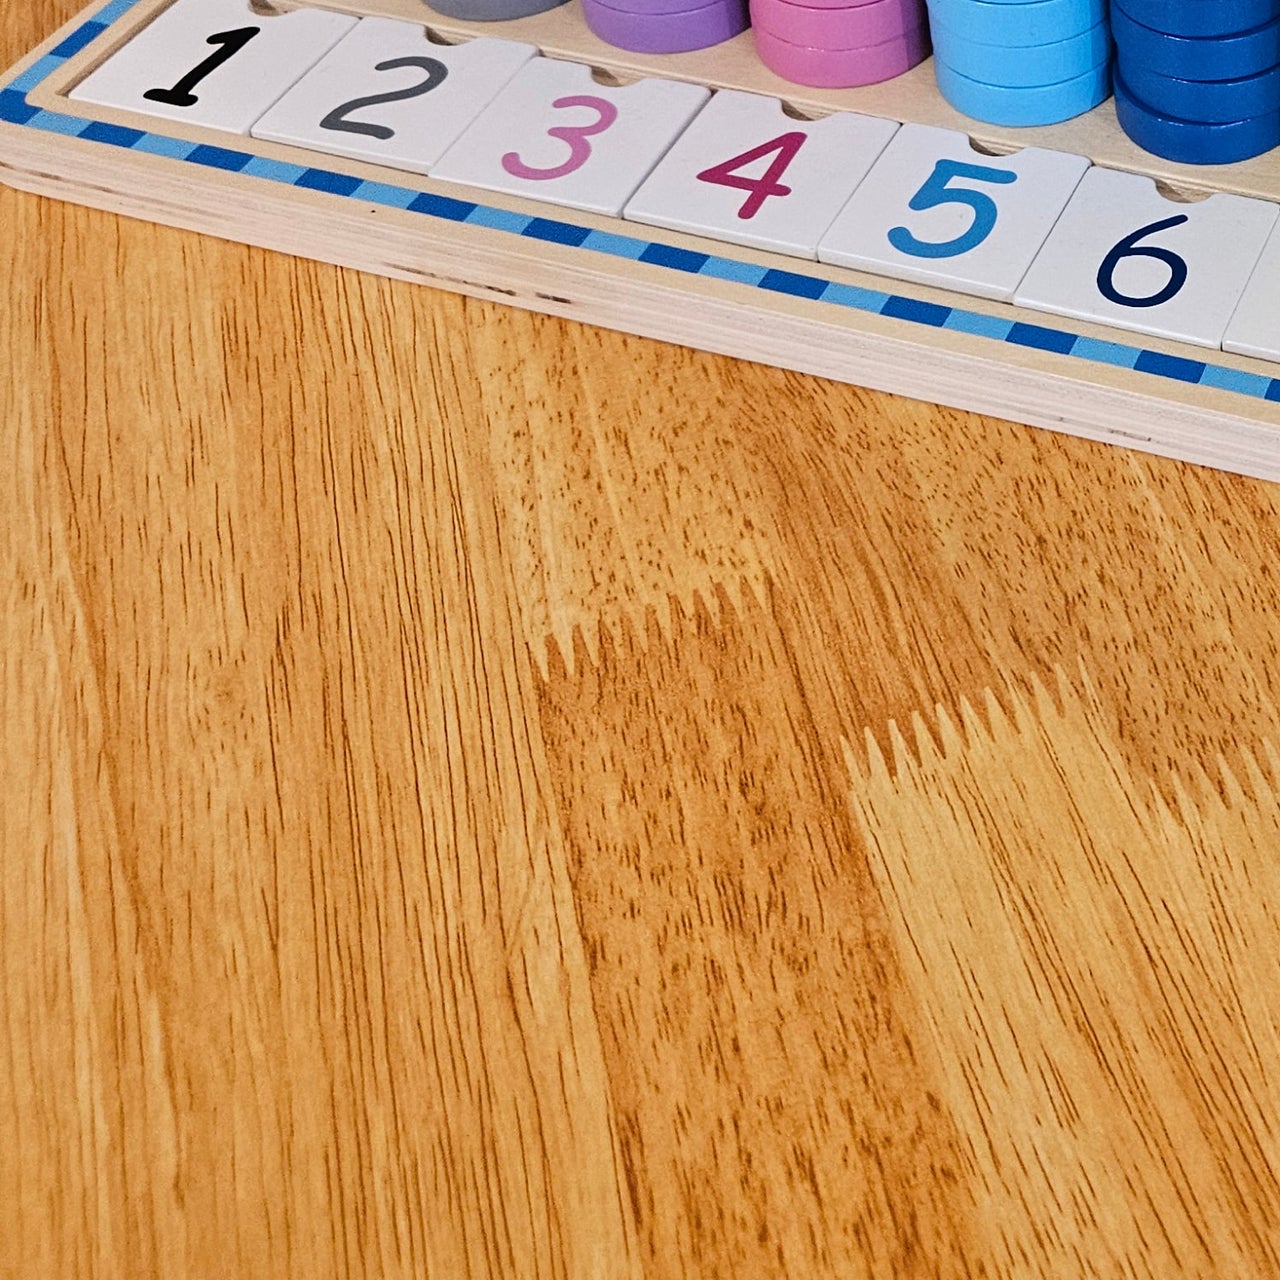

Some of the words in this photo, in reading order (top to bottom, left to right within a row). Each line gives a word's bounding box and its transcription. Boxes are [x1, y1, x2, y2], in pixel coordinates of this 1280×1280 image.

[143, 26, 261, 107] 1
[319, 56, 449, 140] 2
[501, 95, 618, 181] 3
[696, 131, 807, 220] 4
[887, 158, 1018, 259] 5
[1096, 214, 1189, 308] 6
